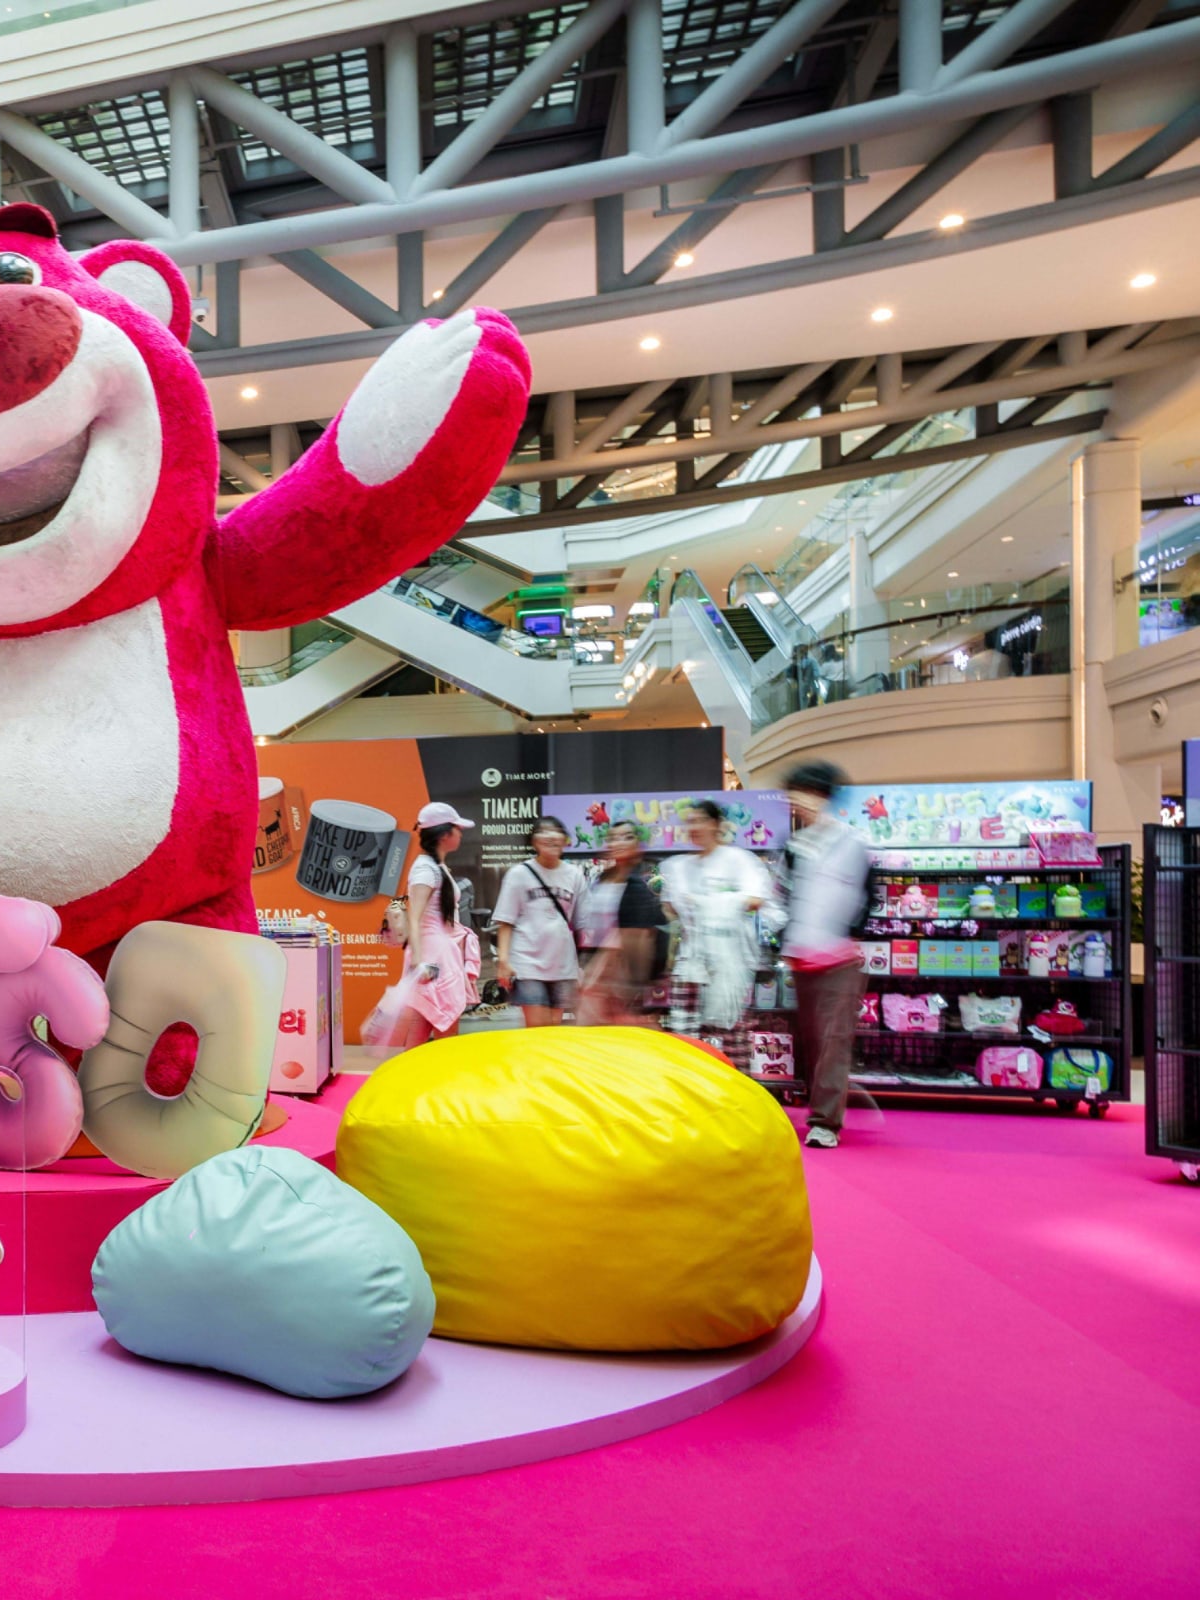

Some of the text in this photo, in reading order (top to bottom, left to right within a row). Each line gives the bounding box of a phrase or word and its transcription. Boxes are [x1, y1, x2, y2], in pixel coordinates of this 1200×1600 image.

[481, 824, 506, 835] PROUD
[343, 828, 367, 852] UP
[304, 862, 352, 896] GRIND
[346, 933, 366, 945] BEAN
